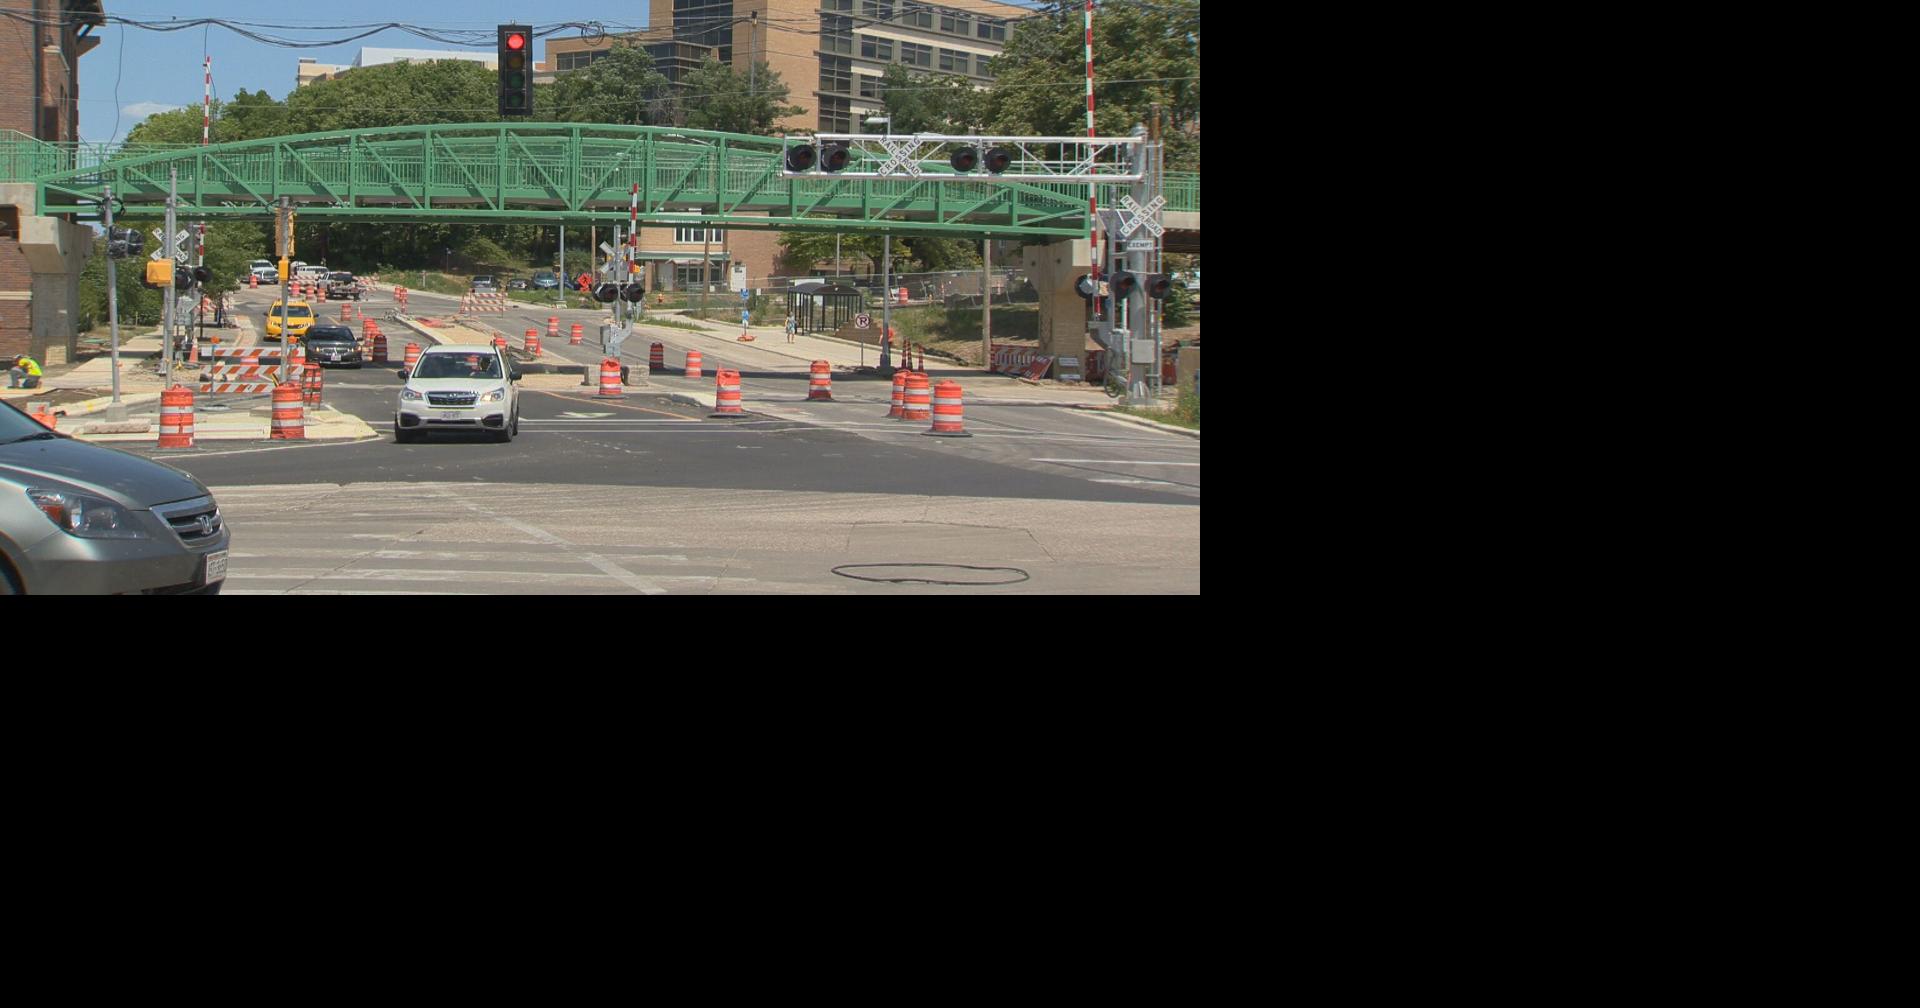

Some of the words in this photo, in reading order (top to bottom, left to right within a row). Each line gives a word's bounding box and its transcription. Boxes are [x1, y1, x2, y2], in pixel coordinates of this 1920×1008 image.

[880, 135, 920, 175] RAILROAD
[880, 136, 920, 174] CROSSING
[1121, 196, 1163, 235] CROSSING
[1121, 196, 1163, 236] RAILROAD
